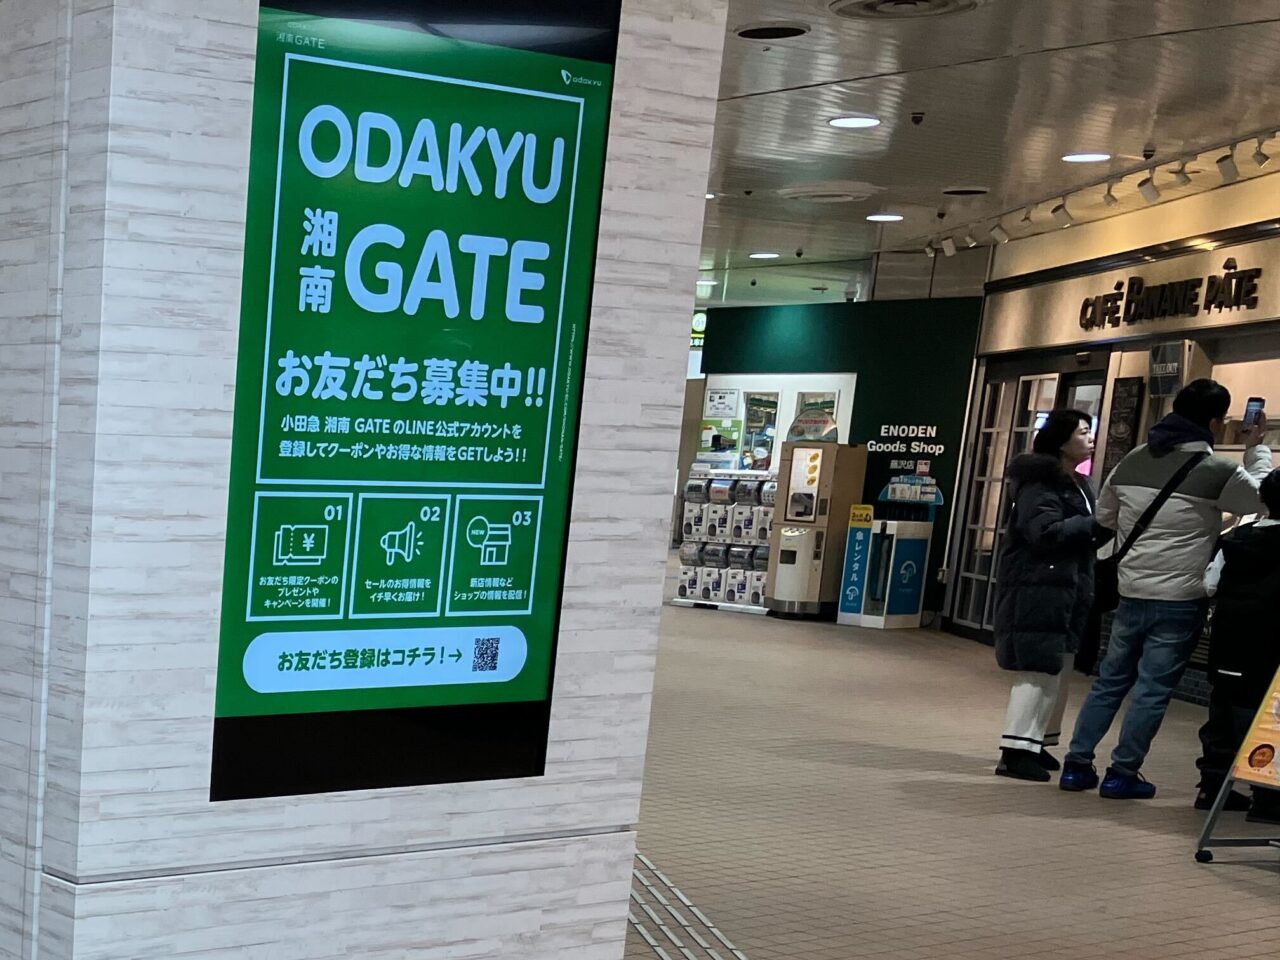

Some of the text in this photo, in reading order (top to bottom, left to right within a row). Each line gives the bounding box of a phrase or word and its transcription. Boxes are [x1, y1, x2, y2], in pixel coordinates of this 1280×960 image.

[572, 76, 602, 87] odakyu
[298, 104, 565, 204] ODAKYU
[298, 207, 339, 314] 湘南
[344, 223, 550, 324] GATE
[1079, 280, 1124, 331] CAFÉ
[1203, 257, 1262, 315] PÂTE
[275, 349, 546, 408] お友だち募集中!!
[280, 414, 523, 440] 小田急 湘南 GATE のLINE公式アカウントを
[880, 424, 937, 437] ENODEN
[867, 440, 945, 456] Goods Shop
[323, 504, 343, 521] 01
[420, 506, 440, 522] 02
[512, 510, 532, 526] 03
[259, 575, 339, 586] お友だち限定クーポンの
[364, 578, 432, 589] セールのお得情報を
[469, 577, 514, 588] 新店情報など
[277, 587, 320, 597] プレゼントや
[277, 646, 445, 672] お友だち登録はコチラ!
